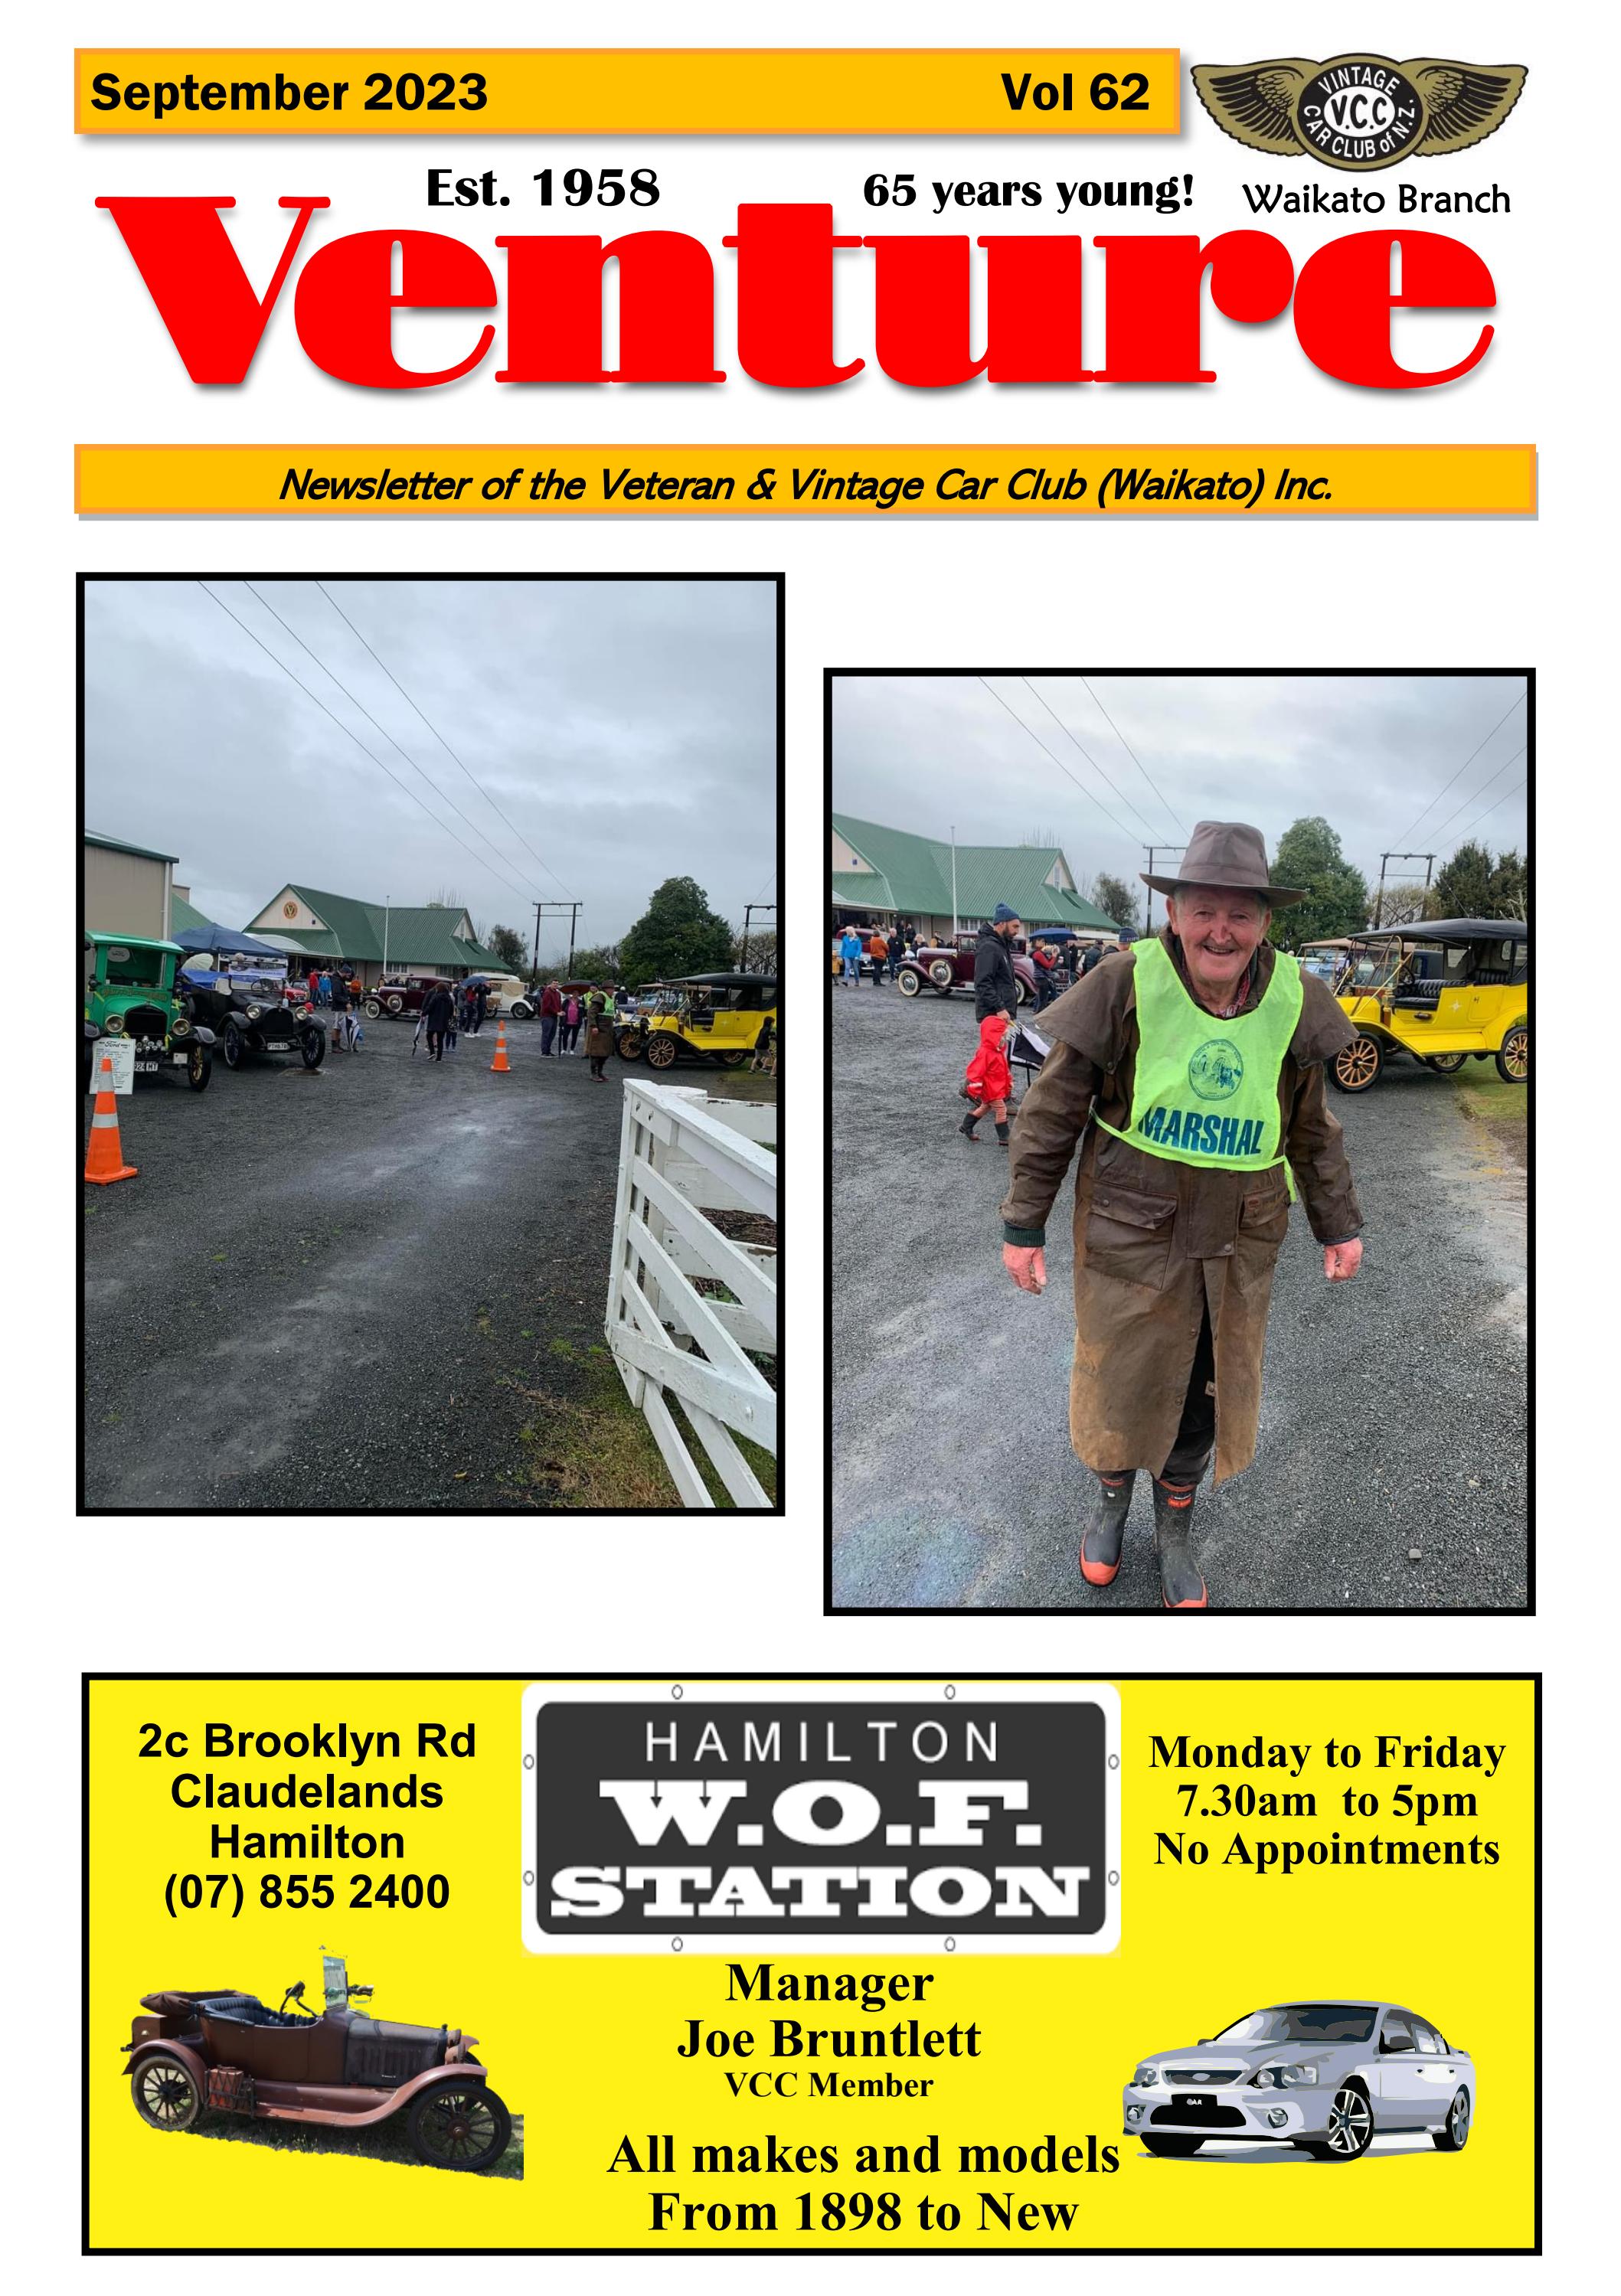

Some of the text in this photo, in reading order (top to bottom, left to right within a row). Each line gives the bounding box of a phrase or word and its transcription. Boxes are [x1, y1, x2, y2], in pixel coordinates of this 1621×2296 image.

[91, 73, 487, 119] September 2023
[1002, 73, 1149, 110] Vol 62
[1318, 67, 1400, 96] VINTAGE
[1331, 94, 1387, 129] V.C.C
[1304, 106, 1332, 146] CAR
[1332, 136, 1376, 158] CLUB
[1380, 131, 1396, 152] of
[428, 168, 659, 206] Est. 1958
[864, 174, 1193, 214] 65 years young!
[1242, 184, 1510, 213] Waikato Branch
[95, 197, 1496, 389] Venture
[279, 469, 1332, 509] Newsletter of the Veteran & Vintage Car Club (Waikato) Inc.
[1138, 1107, 1264, 1156] MARSHAL
[139, 1723, 475, 1766] 2c Brooklyn Rd
[645, 1721, 998, 1762] HAMILTON
[1149, 1736, 1506, 1776] Monday to Friday
[172, 1774, 443, 1808] Claudelands
[1178, 1785, 1478, 1825] 7.30am to 5pm
[599, 1780, 1042, 1846] W.O.F.
[212, 1824, 404, 1858] Hamilton
[1154, 1832, 1499, 1873] No Appointments
[165, 1874, 449, 1917] (07) 855 2400
[551, 1867, 1090, 1916] STATION
[726, 1964, 933, 2011] Manager
[678, 2020, 981, 2057] Joe Bruntlett
[725, 2072, 933, 2097] VCC Member
[606, 2135, 1120, 2173] All makes and models
[649, 2193, 1079, 2230] From 1898 to New
